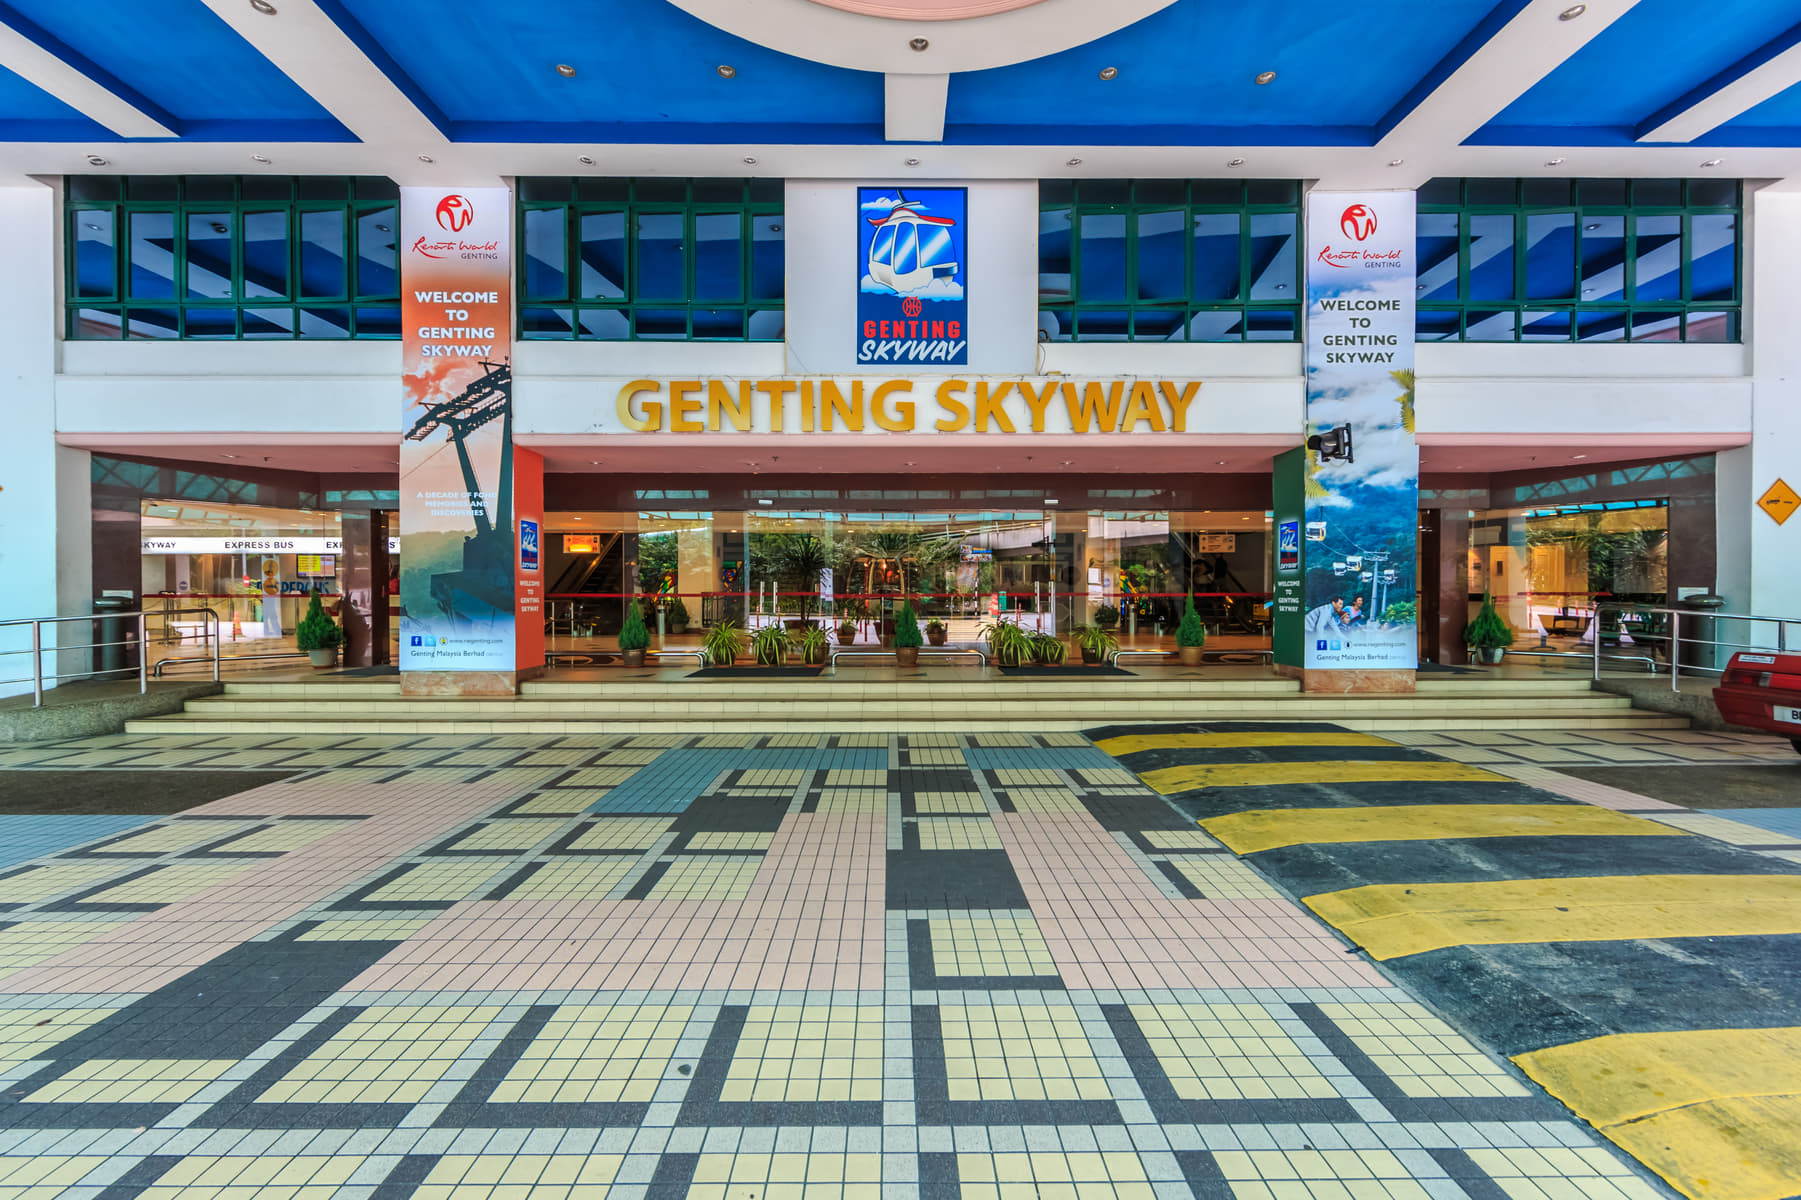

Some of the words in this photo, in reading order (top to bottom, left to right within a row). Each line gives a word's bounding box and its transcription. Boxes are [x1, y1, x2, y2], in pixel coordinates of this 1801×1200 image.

[459, 241, 499, 251] World
[461, 252, 498, 260] GENTING
[1363, 249, 1402, 259] World
[1364, 261, 1401, 269] GENTING
[414, 291, 498, 303] WELCOME
[1320, 300, 1400, 311] WELCOME
[445, 309, 469, 321] TO
[1349, 317, 1371, 328] TO
[418, 327, 495, 339] GENTING
[864, 320, 960, 339] GENTING
[1323, 335, 1397, 346] GENTING
[422, 345, 492, 357] SKYWAY
[858, 339, 966, 361] SKYWAY
[1326, 352, 1395, 363] SKYWAY
[615, 379, 915, 433] GENTING
[935, 380, 1202, 433] SKYWAY
[142, 541, 176, 549] KYWAY
[225, 541, 271, 549] EXPRESS
[274, 541, 294, 549] BUS
[410, 650, 435, 658] Genting
[437, 650, 461, 658] Malaysia
